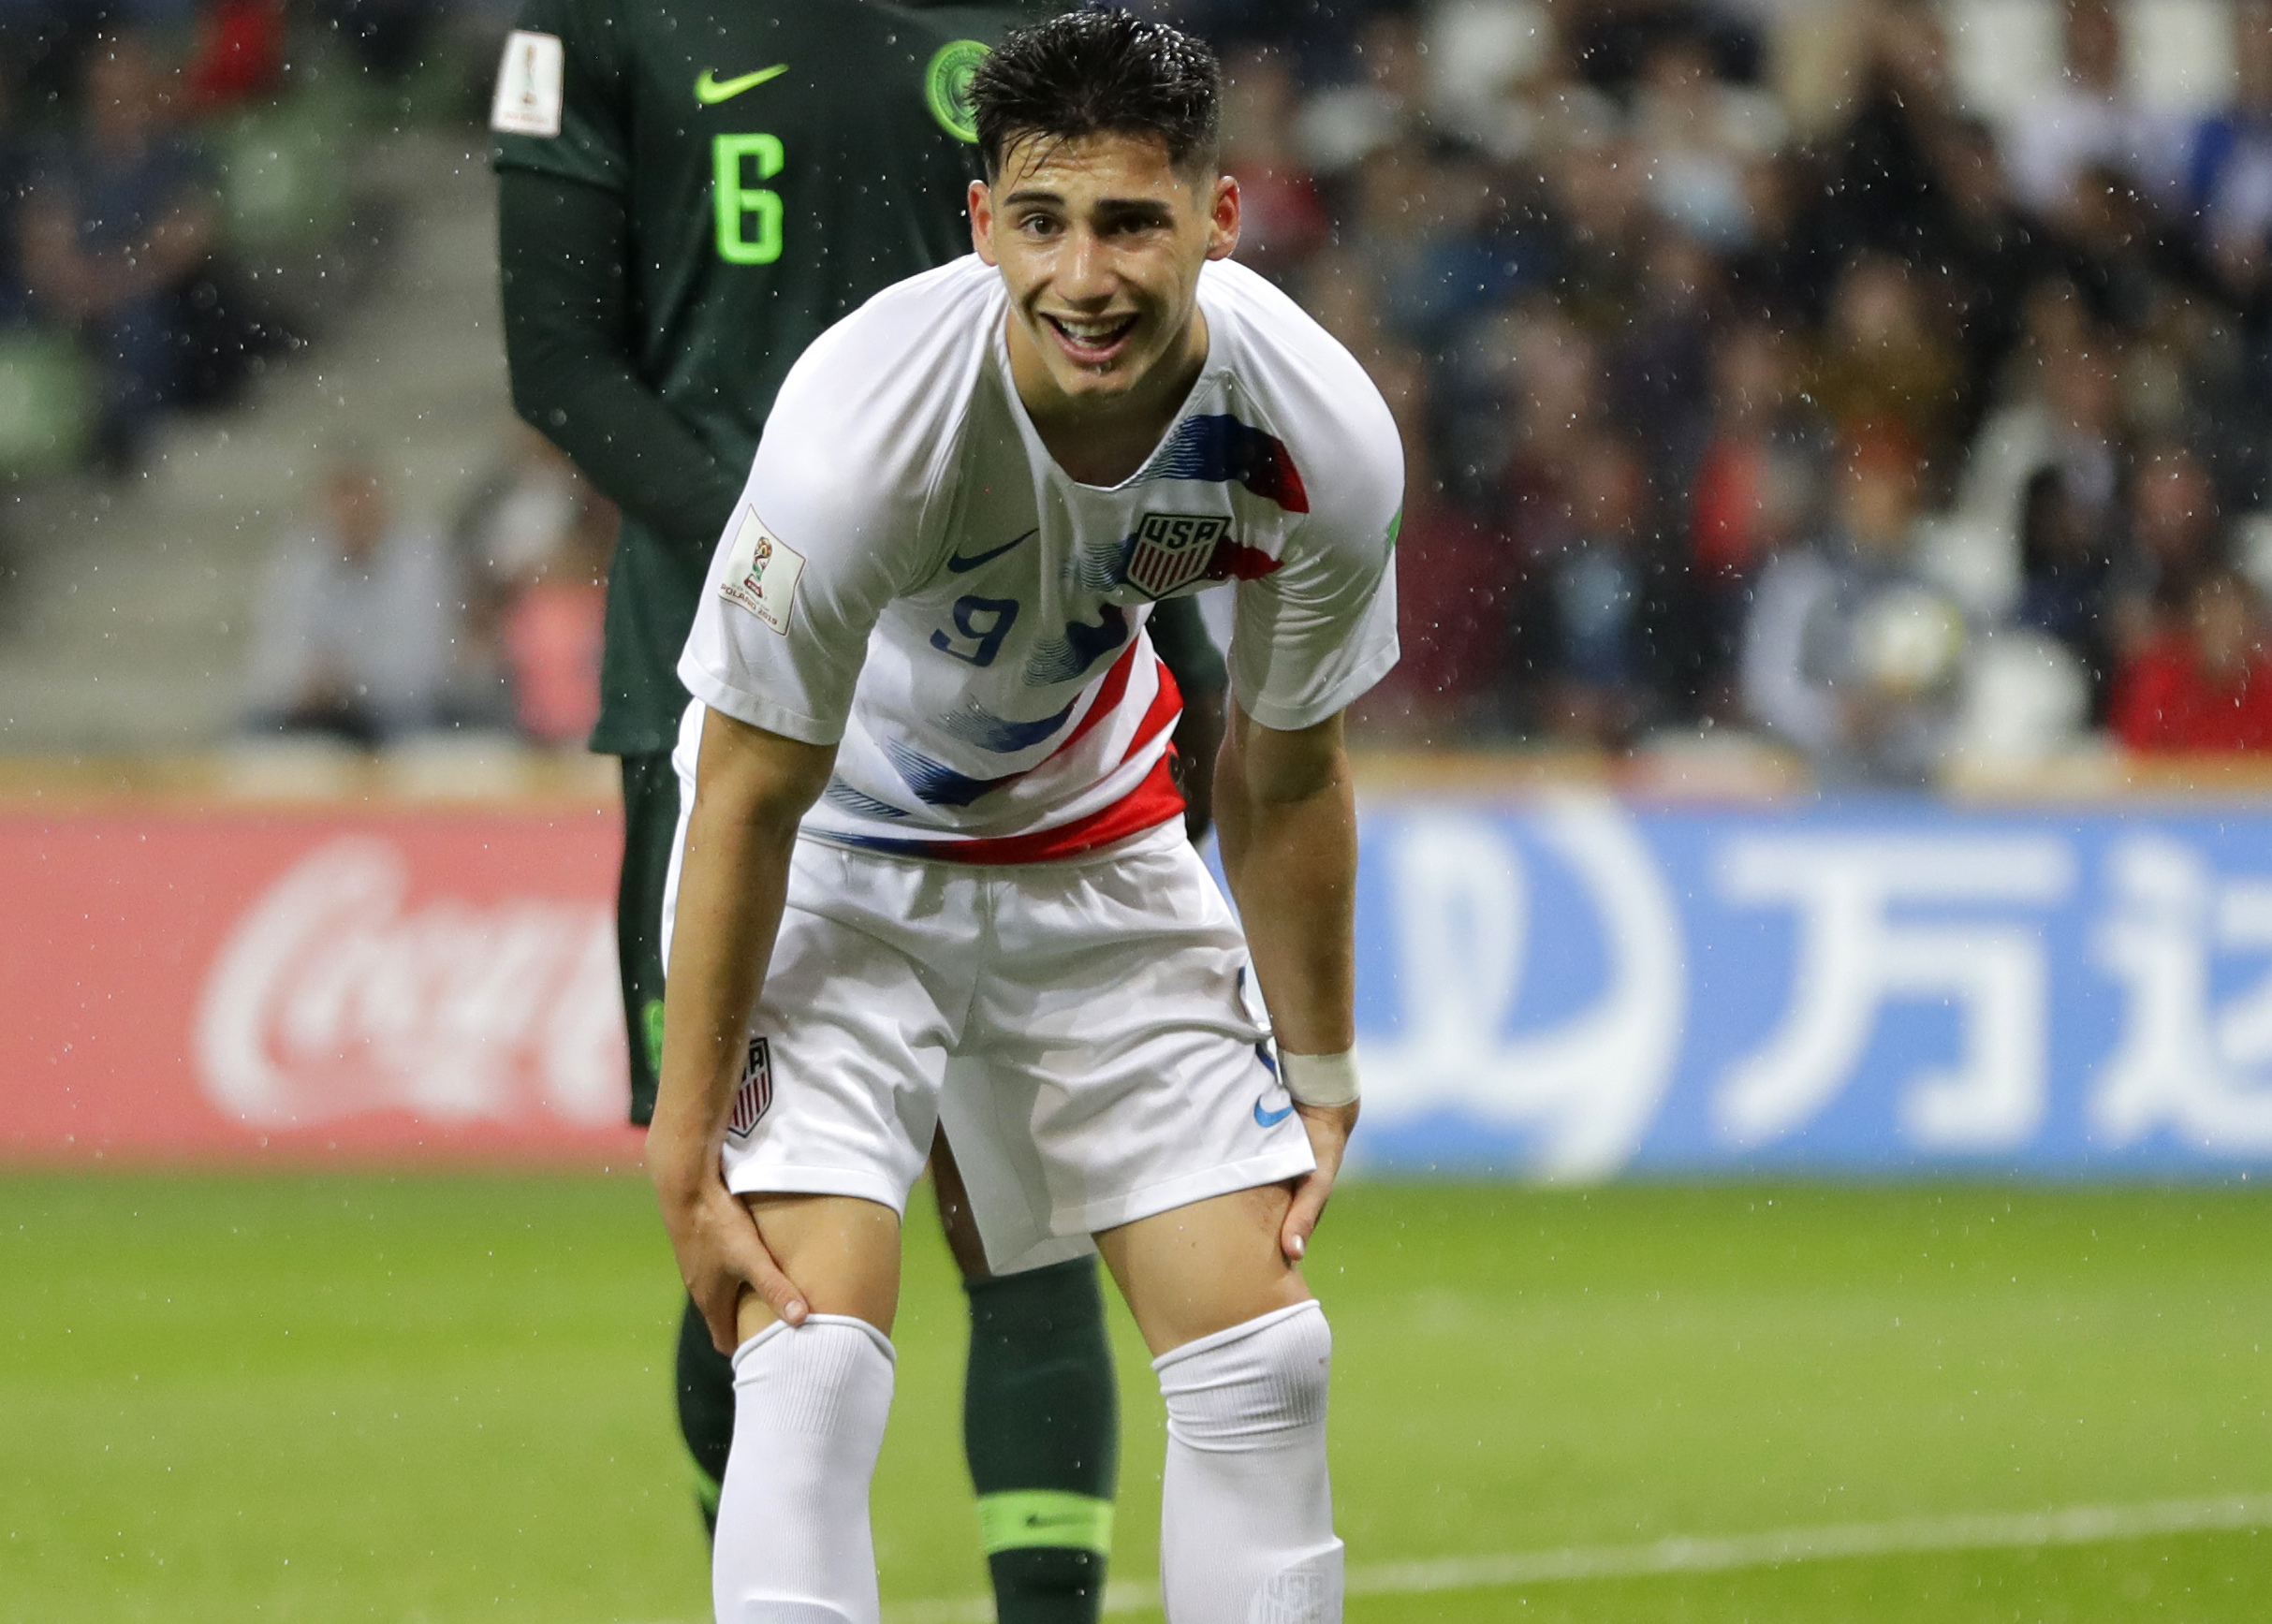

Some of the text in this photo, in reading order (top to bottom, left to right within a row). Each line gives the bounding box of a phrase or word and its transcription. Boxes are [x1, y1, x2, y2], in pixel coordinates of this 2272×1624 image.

[712, 133, 784, 265] 6
[1145, 518, 1222, 550] USA
[722, 583, 756, 609] POLAND
[930, 594, 1019, 667] 9
